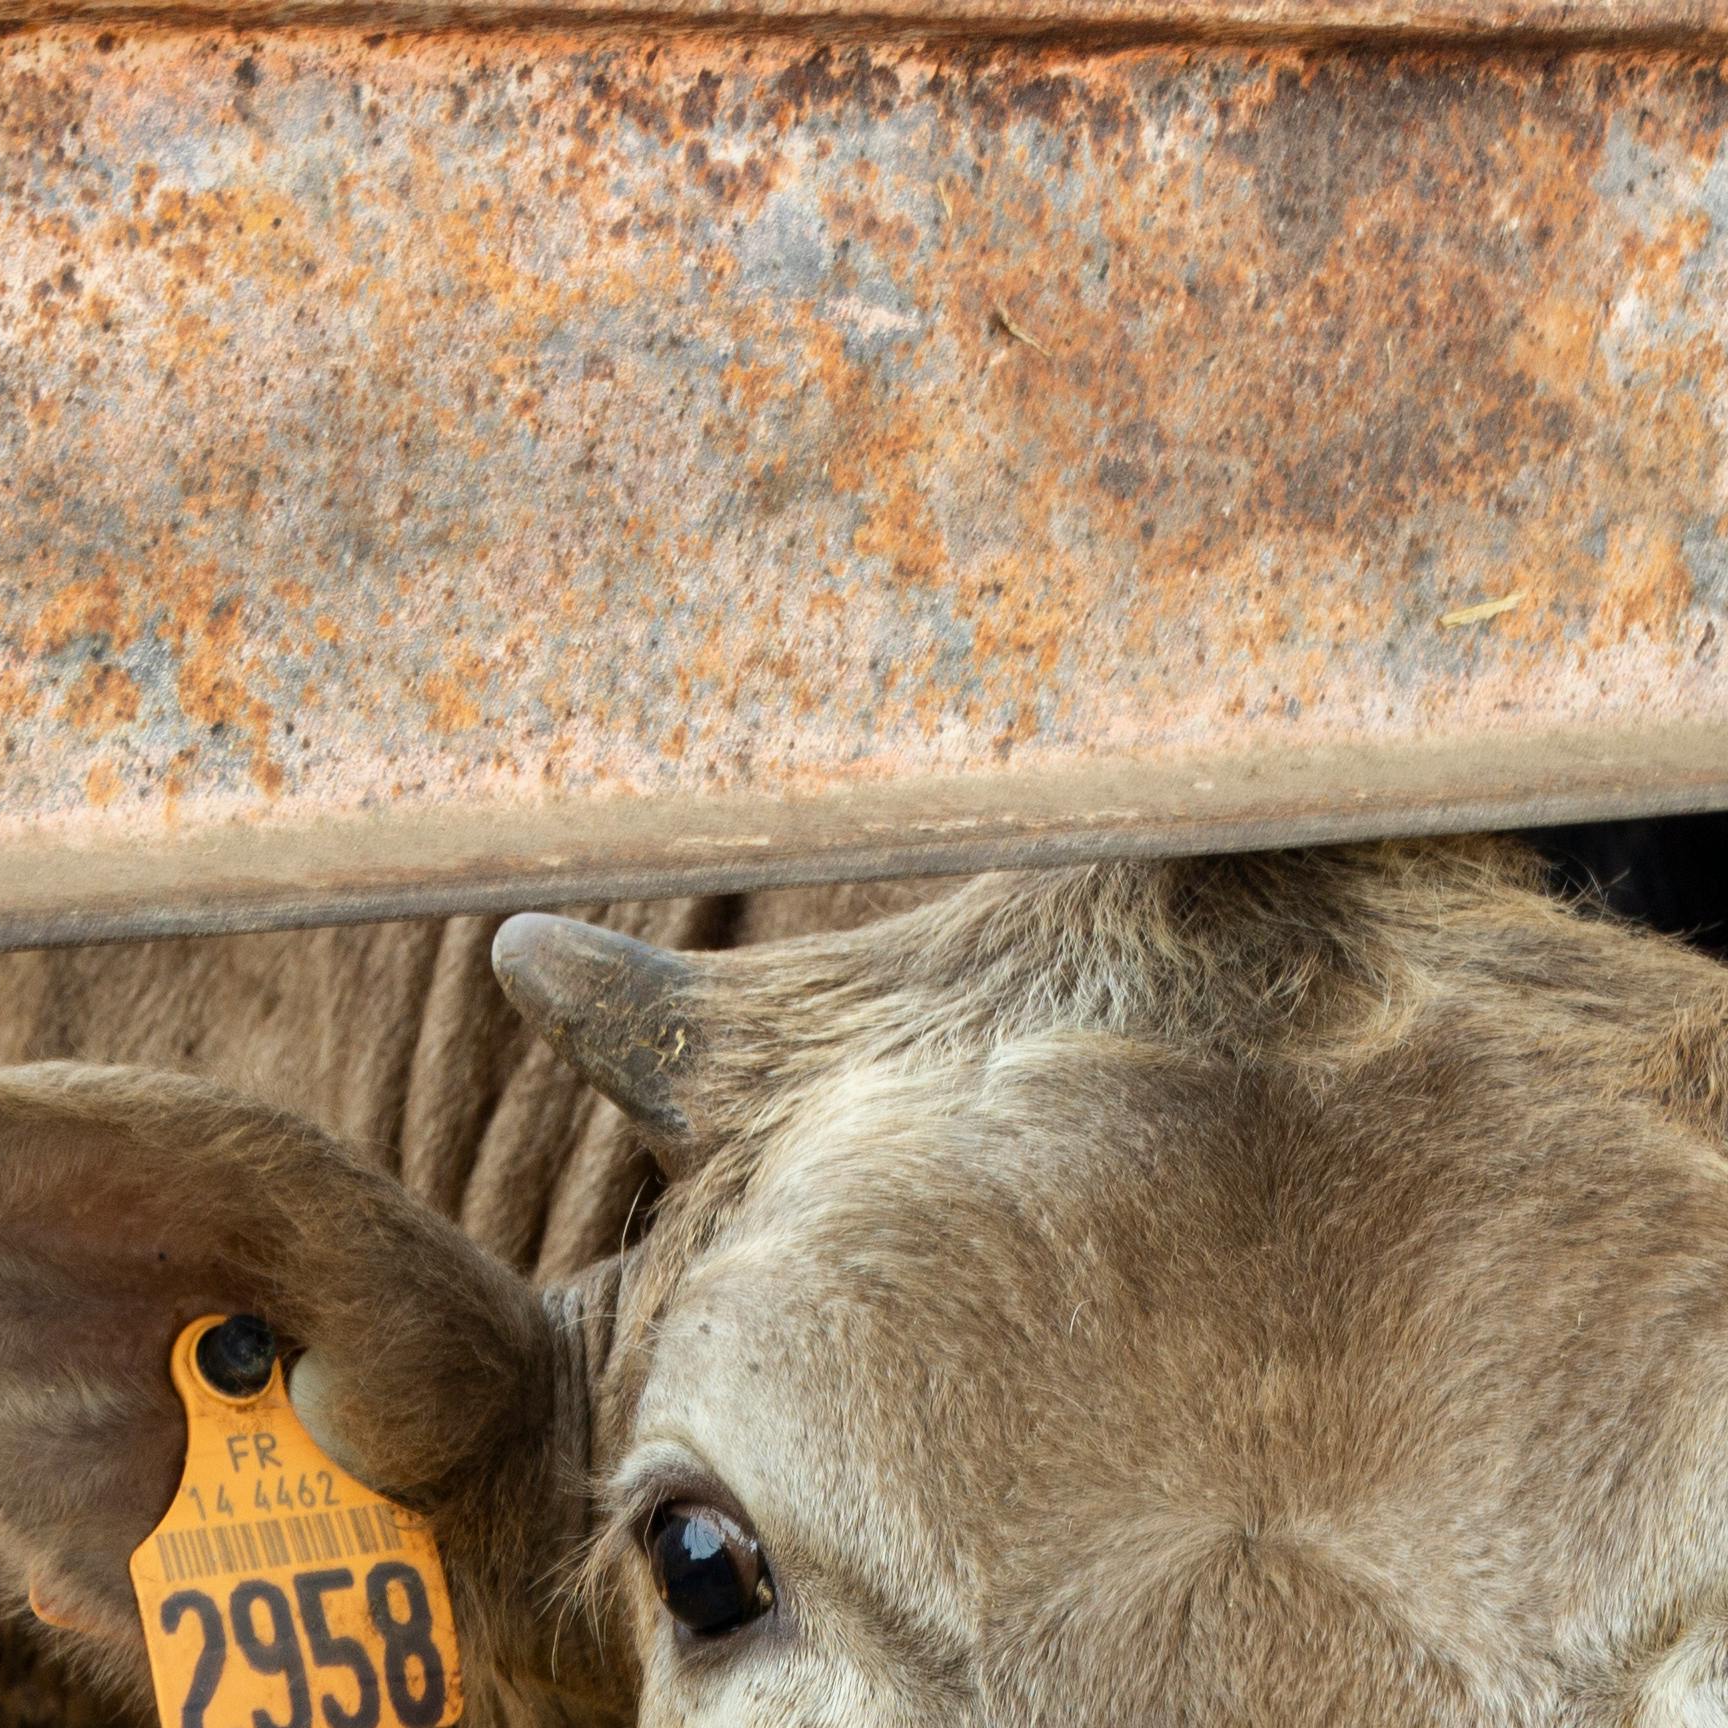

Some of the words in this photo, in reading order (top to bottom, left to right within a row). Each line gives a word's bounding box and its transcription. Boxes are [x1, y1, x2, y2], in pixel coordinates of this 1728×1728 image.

[226, 1432, 283, 1473] FR
[188, 1483, 234, 1521] 14
[254, 1470, 341, 1513] 4462
